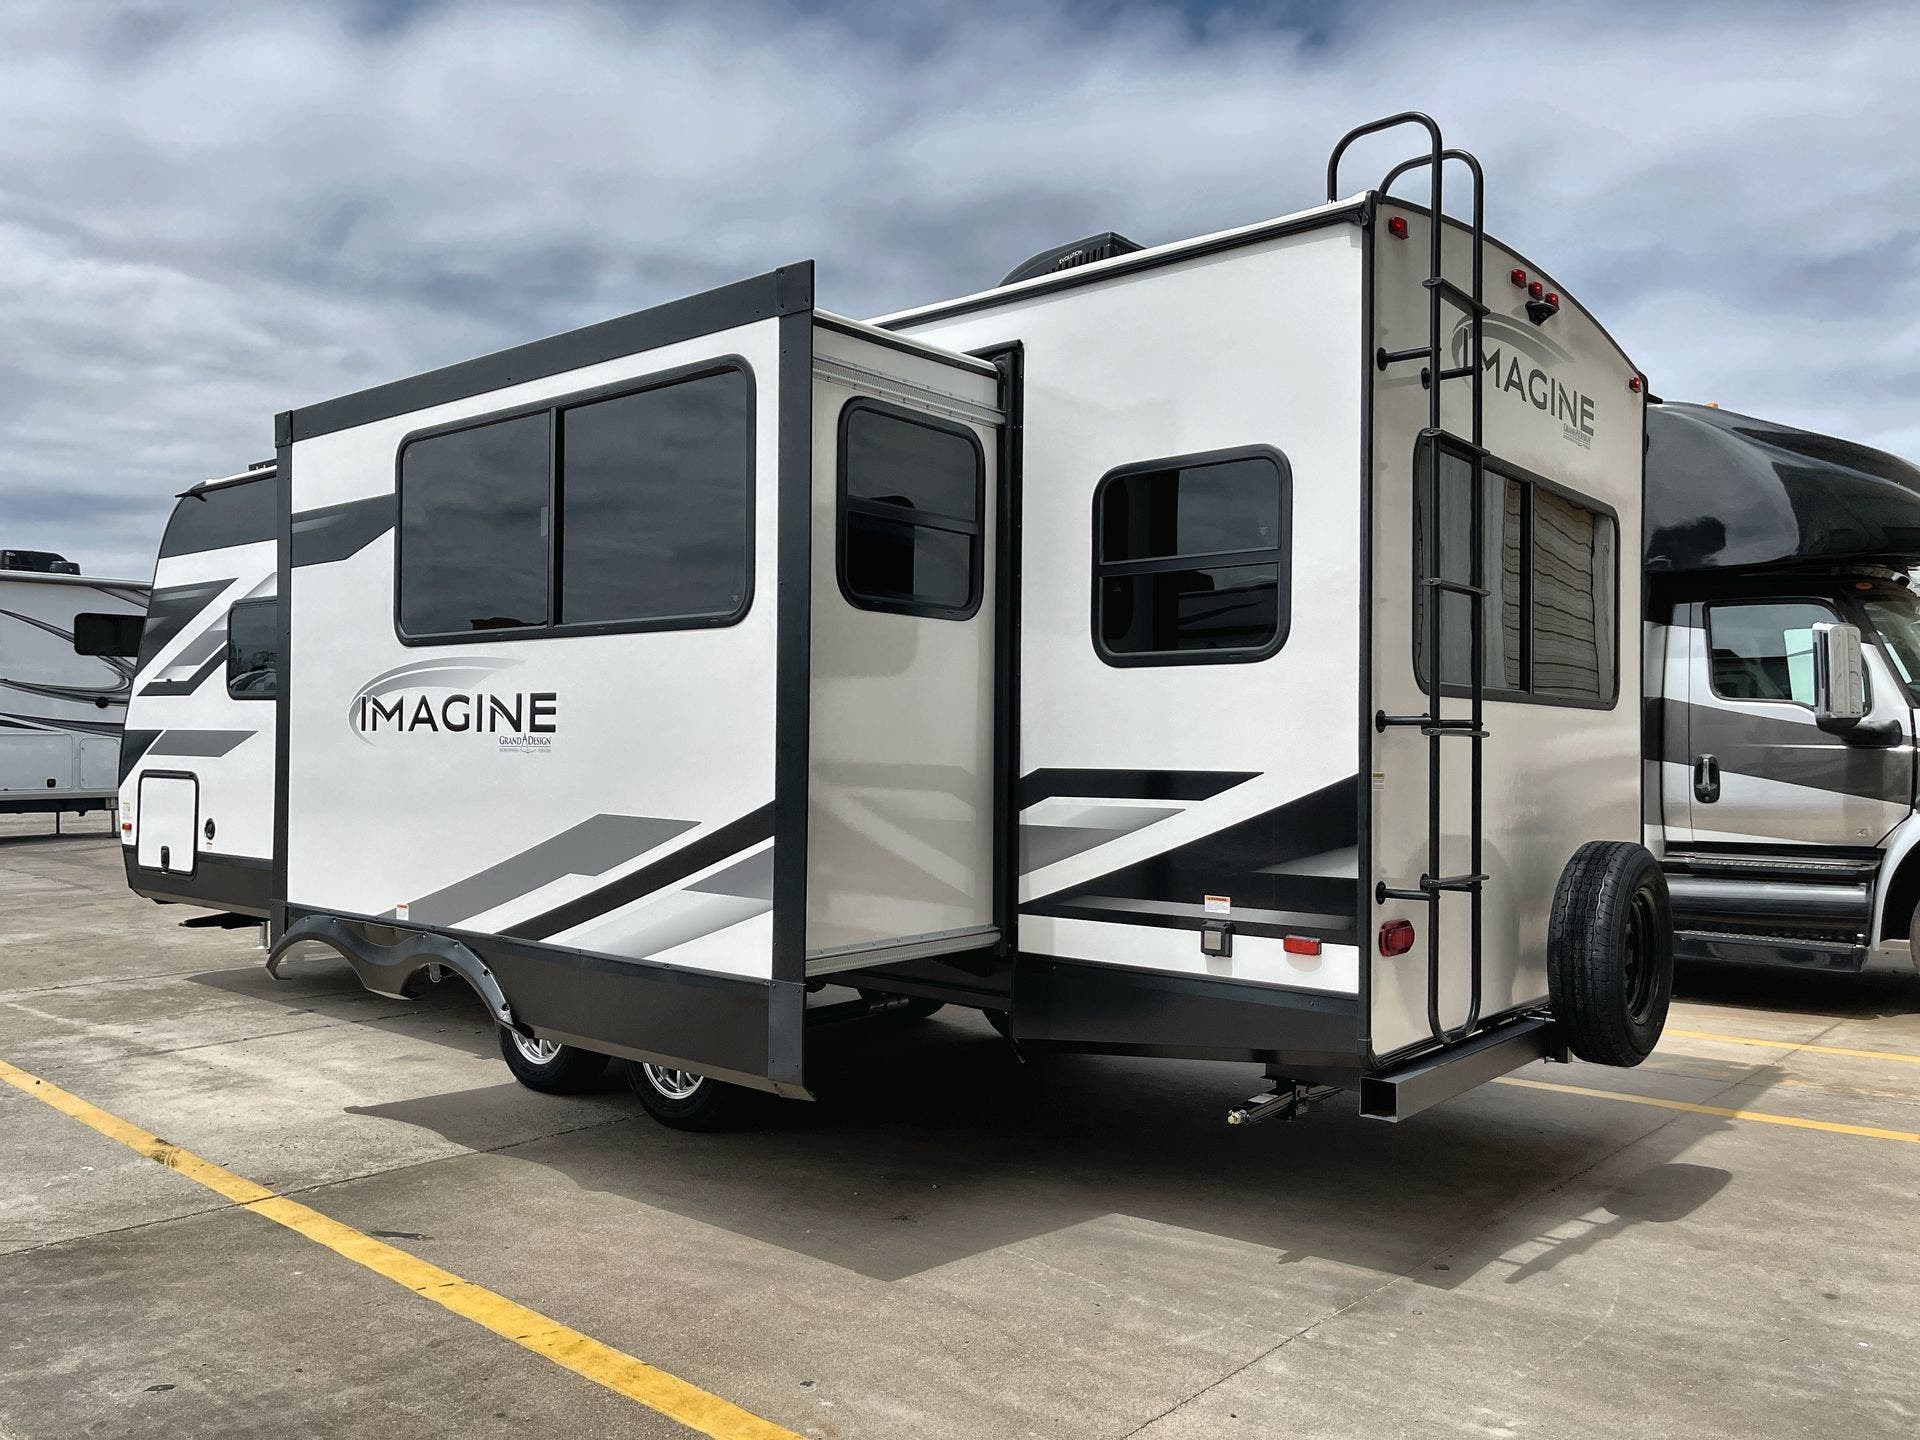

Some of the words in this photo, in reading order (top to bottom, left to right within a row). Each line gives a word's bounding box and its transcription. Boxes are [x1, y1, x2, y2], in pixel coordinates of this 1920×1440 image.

[1463, 327, 1595, 437] IMAGINE
[361, 692, 557, 733] IMAGINE
[499, 735, 522, 745] GRAND
[527, 735, 552, 746] DESIGN
